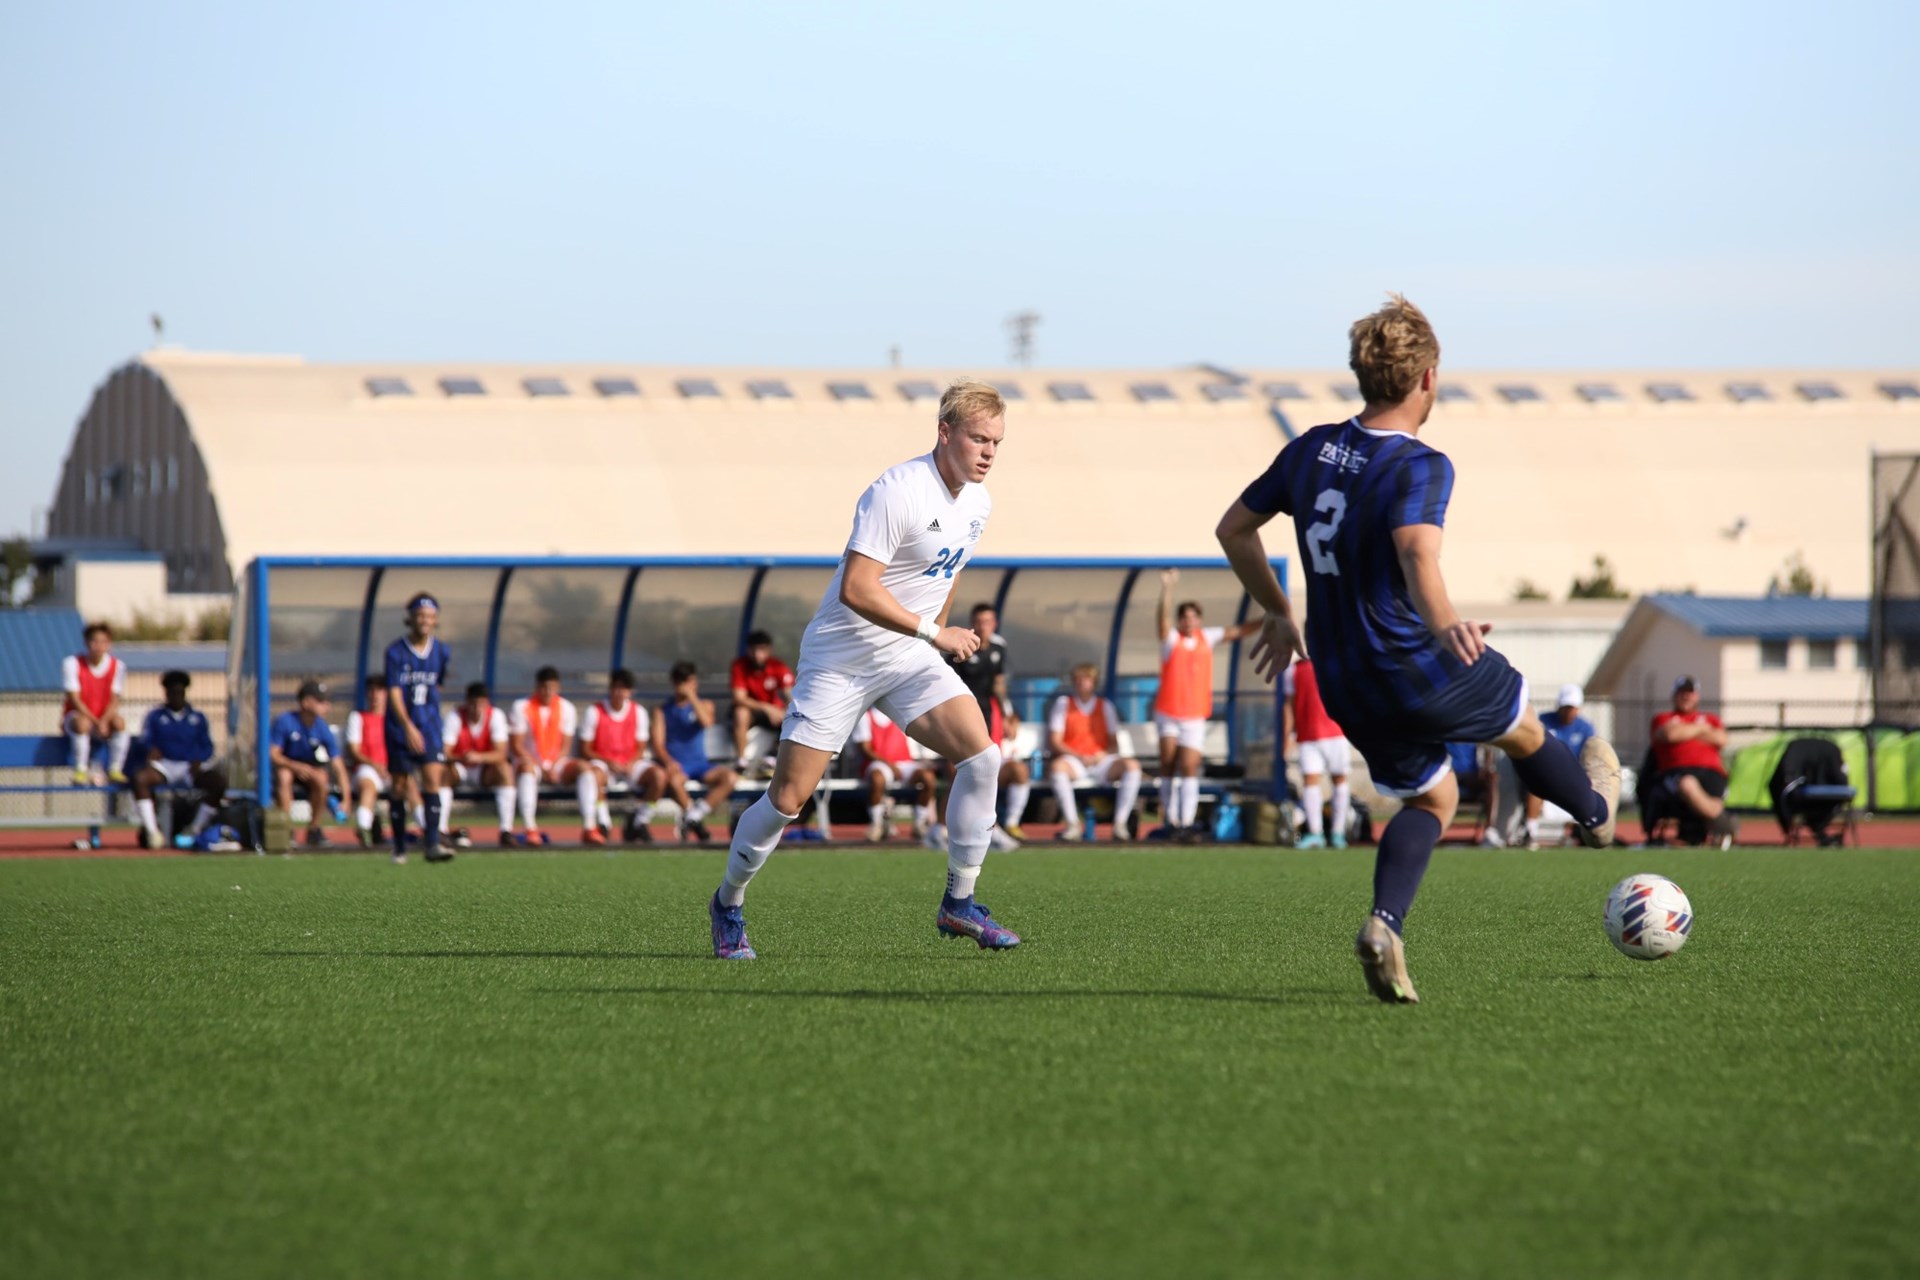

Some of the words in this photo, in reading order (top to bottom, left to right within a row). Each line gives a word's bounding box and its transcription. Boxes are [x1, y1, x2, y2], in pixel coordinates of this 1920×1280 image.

[1319, 441, 1369, 469] PATR
[1305, 488, 1348, 576] 2
[922, 547, 965, 579] 24
